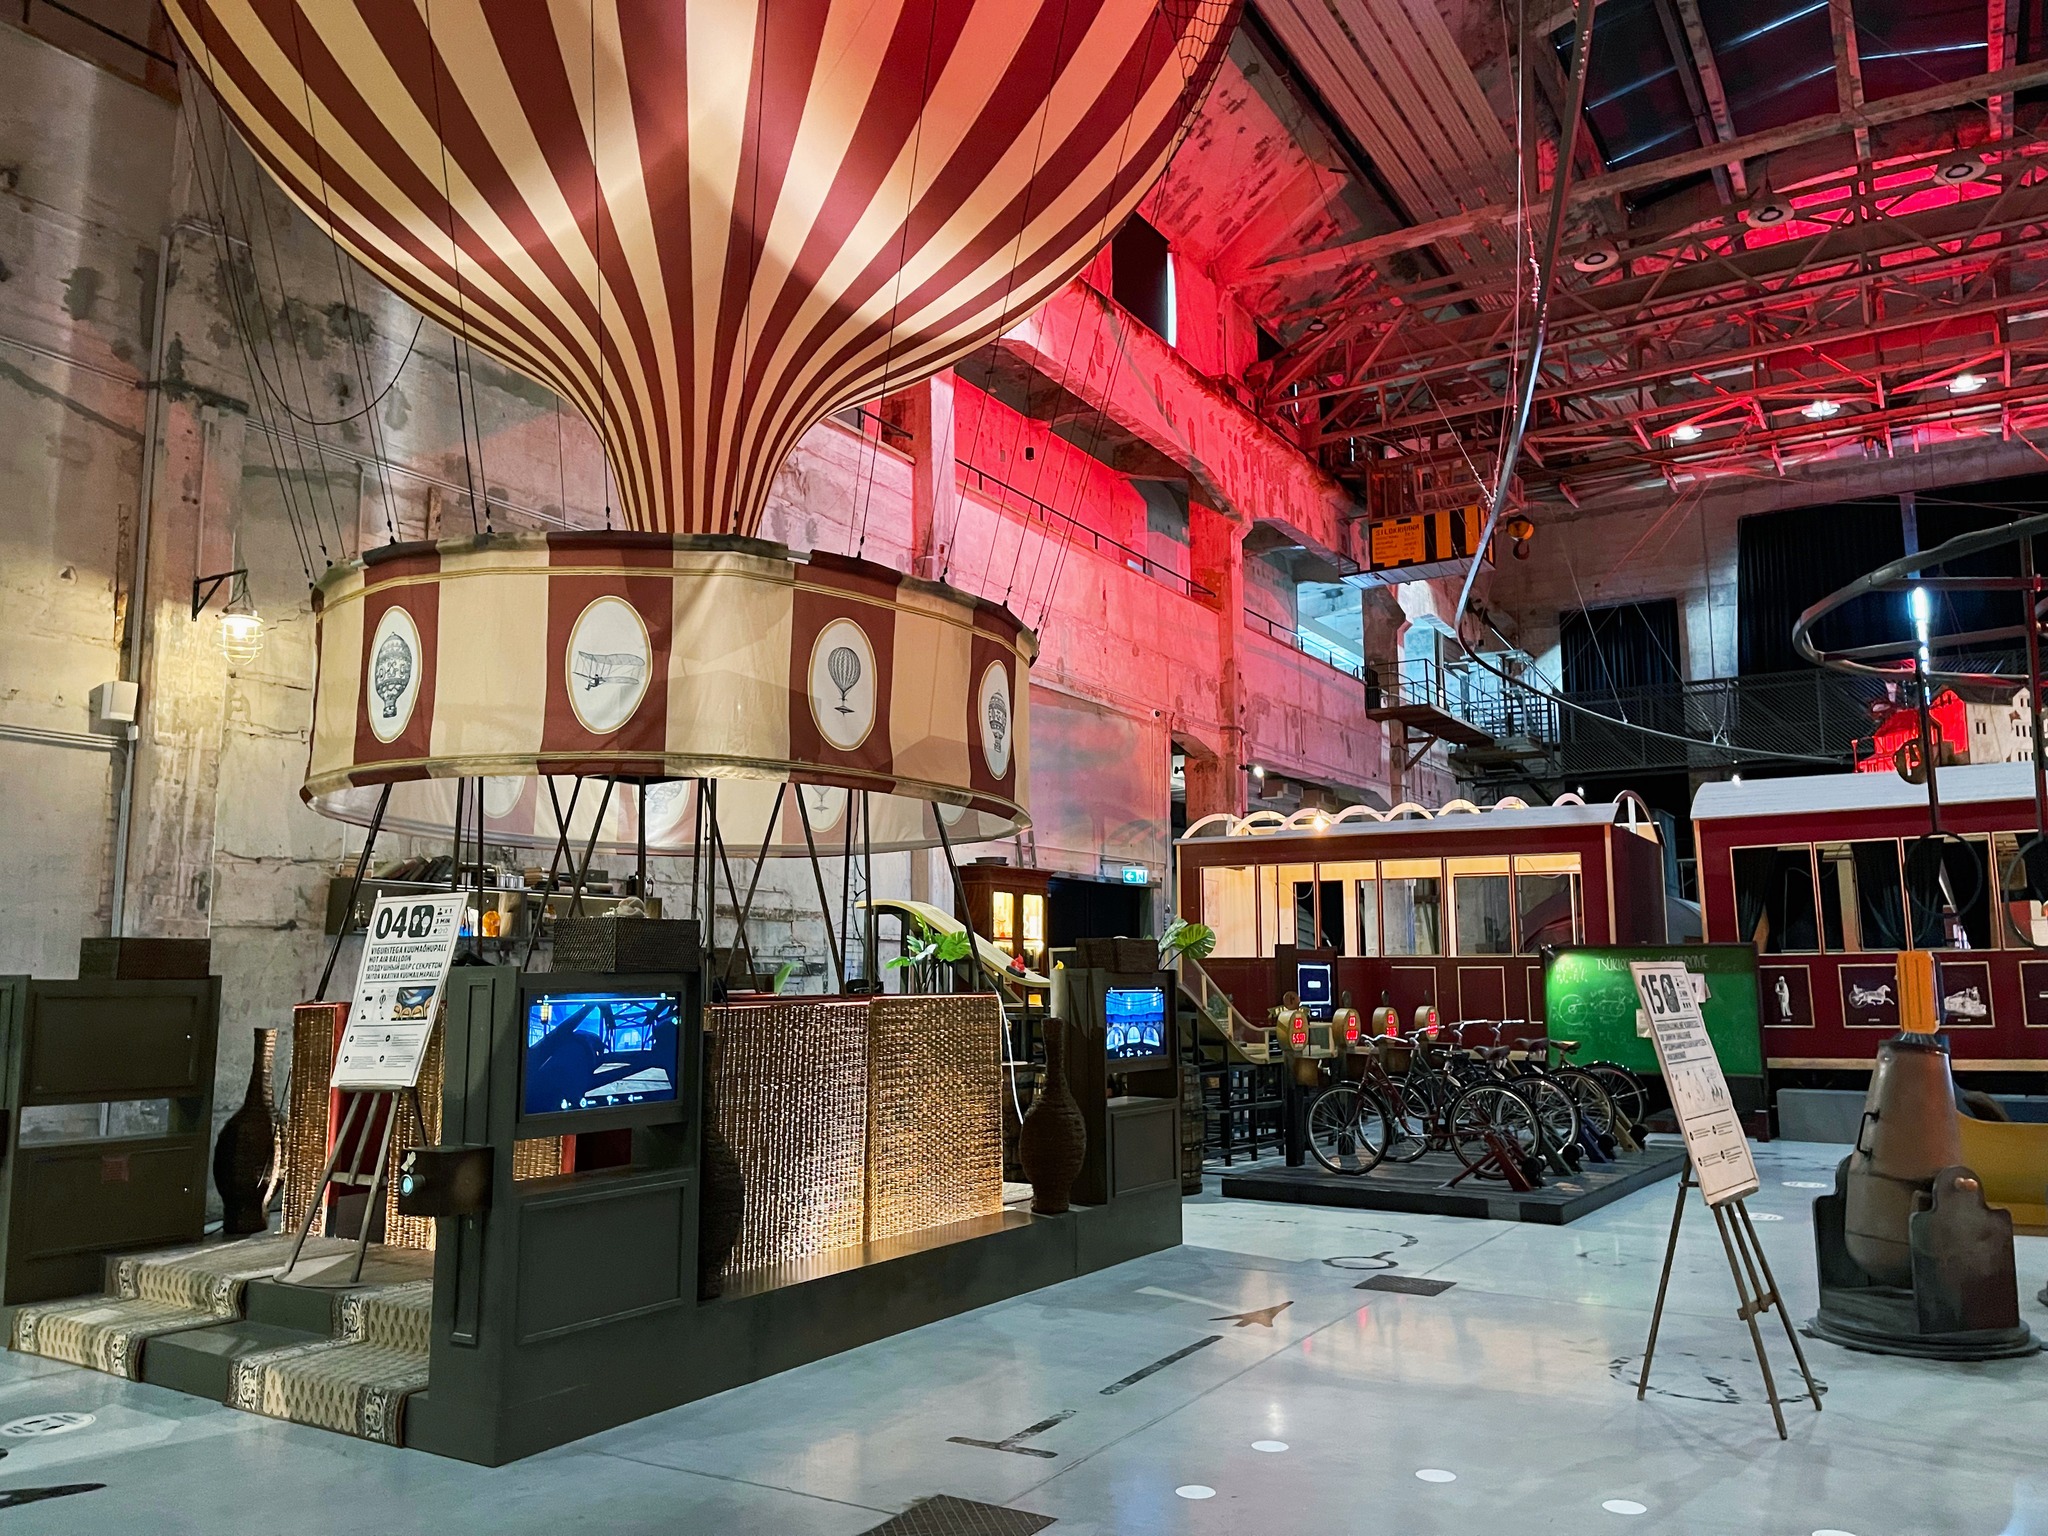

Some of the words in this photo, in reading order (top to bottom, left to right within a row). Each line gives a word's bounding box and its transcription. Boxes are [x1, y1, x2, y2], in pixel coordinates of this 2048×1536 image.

[376, 906, 408, 939] 04
[379, 955, 389, 963] AIR
[389, 955, 412, 963] BALLOON
[1641, 974, 1665, 1014] 15
